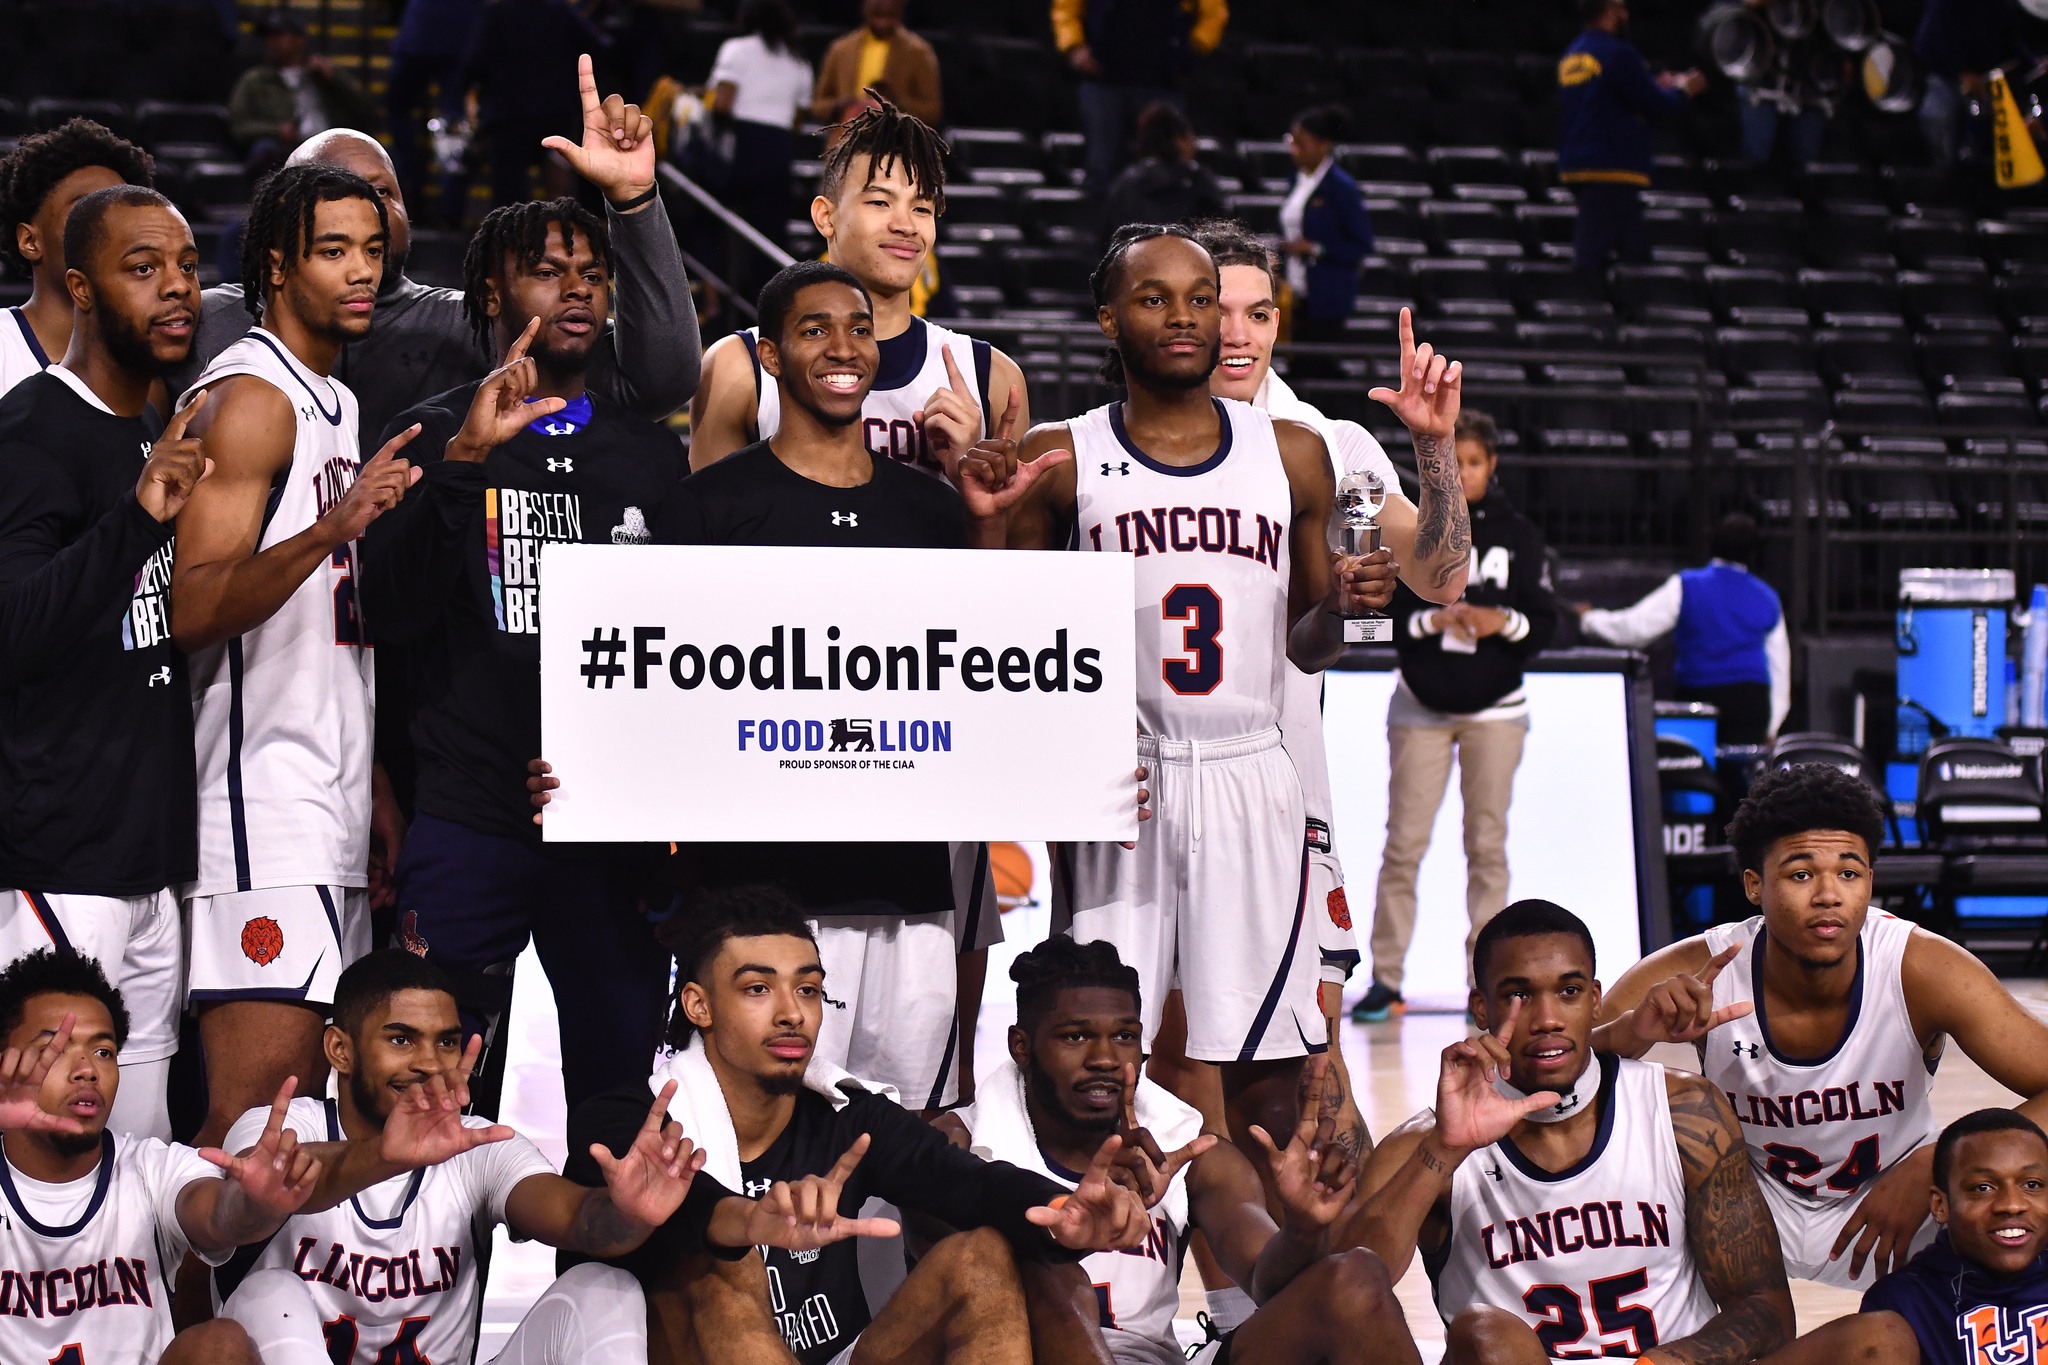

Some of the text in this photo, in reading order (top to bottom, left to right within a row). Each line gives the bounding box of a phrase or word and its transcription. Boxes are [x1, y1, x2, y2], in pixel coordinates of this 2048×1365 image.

[1089, 507, 1283, 573] LINCOLN
[580, 625, 1103, 693] #FoodLionFeeds
[1162, 583, 1224, 696] 3
[738, 719, 952, 752] FOOD LION
[779, 760, 915, 769] PROUD SPONSOR OF THE CIAA
[1726, 1080, 1905, 1129] LINCOLN
[1762, 1133, 1881, 1196] 24
[1480, 1200, 1671, 1270] LINCOLN
[0, 1257, 153, 1319] INCOLN
[292, 1236, 461, 1303] LINCOLN
[1521, 1266, 1659, 1361] 25
